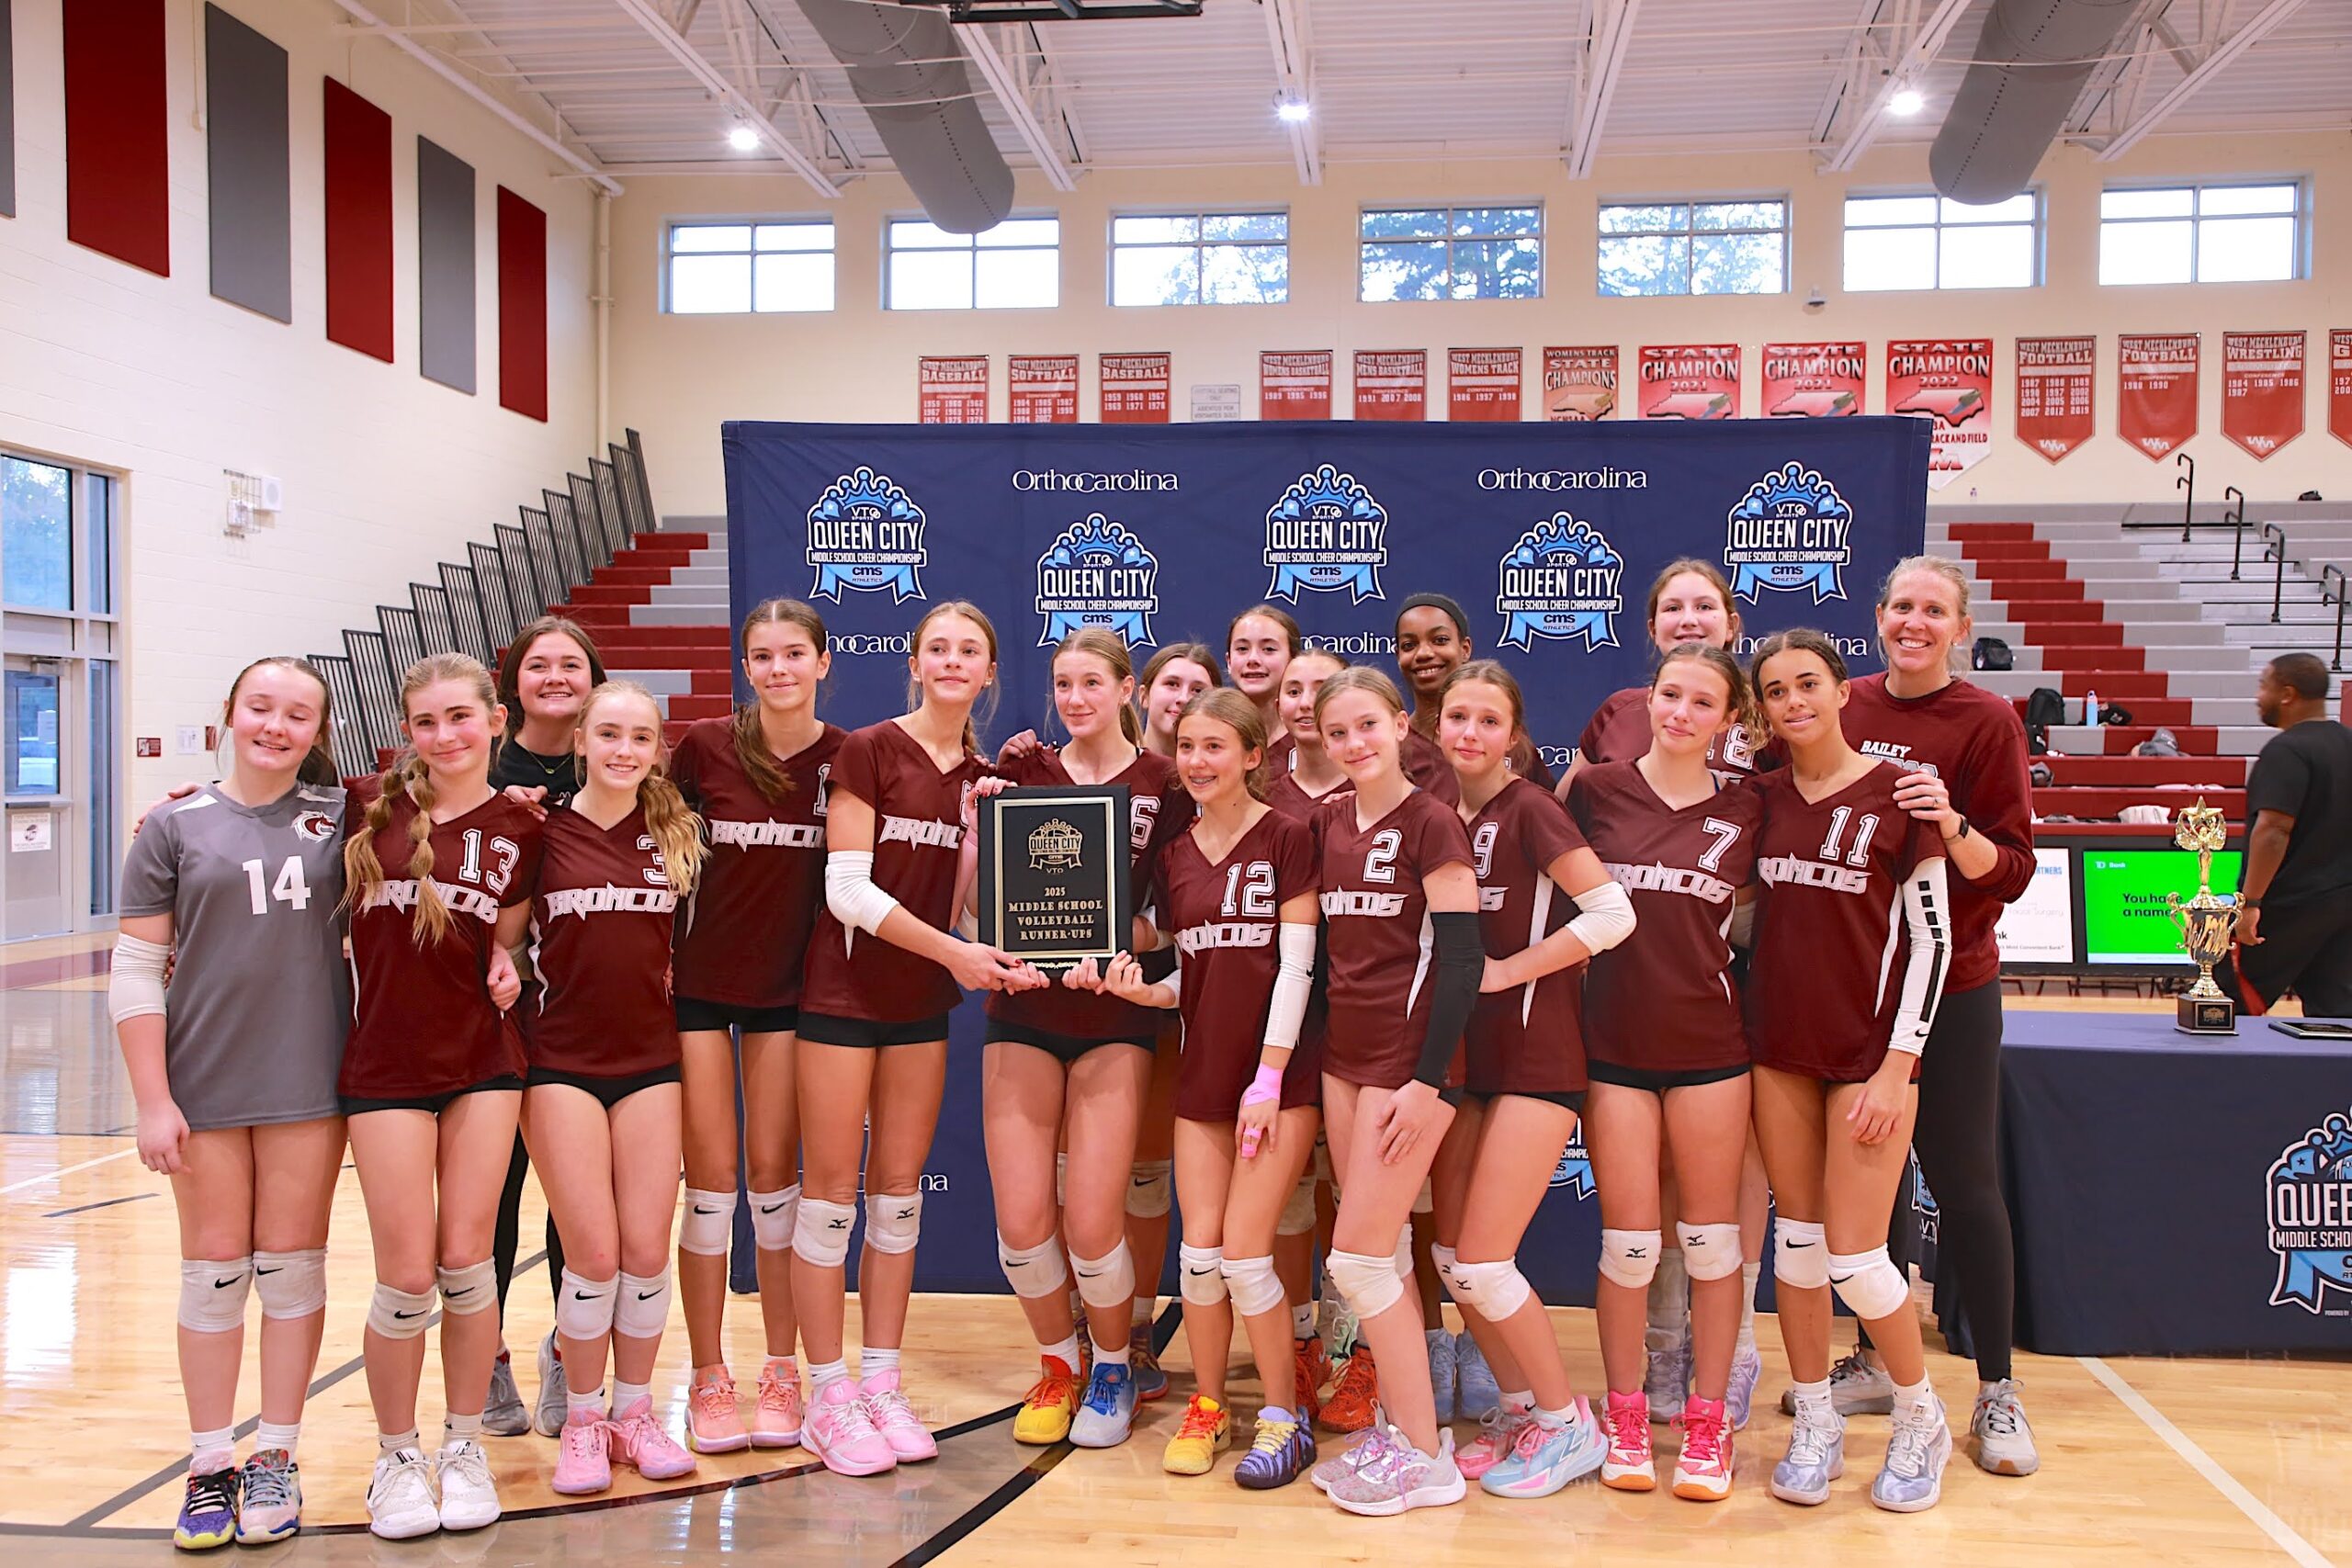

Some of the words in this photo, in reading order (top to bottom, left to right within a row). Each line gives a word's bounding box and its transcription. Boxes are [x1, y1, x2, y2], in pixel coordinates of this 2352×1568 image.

[1893, 343, 1984, 353] STATE
[2019, 343, 2039, 351] WEST
[2041, 342, 2092, 353] MECKLENBURG
[2122, 340, 2143, 350] WEST
[2144, 339, 2196, 351] MECKLENBURG
[2228, 338, 2247, 347] WEST
[2250, 336, 2302, 348] MECKLENBURG
[1645, 348, 1734, 358] STATE
[1769, 346, 1858, 356] STATE
[2019, 351, 2092, 364] FOOTBALL
[2122, 348, 2196, 362] FOOTBALL
[2227, 346, 2301, 359] WRESTLING
[1379, 363, 1423, 375] BASKETBALL
[1452, 362, 1488, 375] WOMENS
[1490, 361, 1519, 374] TRACK
[1550, 358, 1611, 368] STATE
[1766, 358, 1863, 380] CHAMPION
[1890, 355, 1990, 377] CHAMPION
[922, 369, 985, 381] BASEBALL
[1012, 368, 1076, 380] SOFTBALL
[1102, 367, 1167, 379] BASEBALL
[1642, 360, 1737, 382] CHAMPION
[1545, 370, 1616, 390] CHAMPIONS
[1671, 381, 1707, 391] 2021
[1794, 379, 1831, 389] 2021
[1919, 377, 1958, 387] 2022
[2021, 398, 2040, 406] 2004
[2021, 408, 2040, 416] 2007
[2045, 407, 2064, 415] 2012
[2071, 406, 2089, 414] 2019
[1951, 434, 1966, 443] AND
[1968, 434, 1987, 442] FIELD
[1012, 469, 1178, 493] OrthoCarolina
[1477, 467, 1647, 491] OrthoCarolina
[813, 522, 873, 549] QUEEN
[879, 522, 919, 550] CITY
[1272, 522, 1332, 549] QUEEN
[1340, 522, 1380, 549] CITY
[1734, 520, 1796, 547] QUEEN
[1804, 519, 1845, 547] CITY
[811, 552, 833, 562] MIDDLE
[834, 552, 856, 562] SCHOOL
[857, 553, 876, 563] CHEER
[877, 553, 922, 563] CHAMPIONSHIP
[1269, 552, 1291, 562] MIDDLE
[1292, 552, 1316, 562] SCHOOL
[1317, 553, 1335, 563] CHEER
[1337, 553, 1382, 563] CHAMPIONSHIP
[1730, 551, 1752, 561] MIDDLE
[1753, 551, 1777, 561] SCHOOL
[1779, 552, 1797, 561] CHEER
[1799, 552, 1845, 562] CHAMPIONSHIP
[852, 567, 883, 575] cms
[1310, 567, 1341, 575] cms
[1771, 566, 1804, 574] cms
[1044, 570, 1104, 597] QUEEN
[1111, 570, 1150, 597] CITY
[1506, 569, 1568, 597] QUEEN
[1575, 569, 1615, 597] CITY
[1041, 600, 1063, 610] MIDDLE
[1064, 600, 1087, 610] SCHOOL
[1088, 601, 1106, 611] CHEER
[1108, 601, 1152, 611] CHAMPIONSHIP
[1502, 600, 1524, 610] MIDDLE
[1525, 600, 1549, 610] SCHOOL
[1550, 601, 1568, 610] CHEER
[1570, 601, 1616, 611] CHAMPIONSHIP
[1081, 615, 1113, 623] cms
[1544, 615, 1576, 623] cms
[826, 631, 915, 654] hoCarol
[1707, 723, 1755, 770] 8
[1860, 740, 1911, 758] BAILEY
[1130, 795, 1160, 849] 6
[709, 817, 824, 852] BRONCO
[878, 815, 962, 852] BRONC
[1819, 806, 1880, 867] 11
[1031, 839, 1058, 849] QUEEN
[1061, 838, 1080, 849] CITY
[1698, 817, 1742, 873] 7
[1363, 829, 1402, 884] 2
[1473, 822, 1498, 879] 9
[458, 829, 519, 896] 13
[637, 835, 670, 886] 3
[1758, 852, 1873, 895] RONCOS
[243, 855, 311, 915] 14
[1221, 861, 1275, 917] 12
[1044, 887, 1066, 897] 2025
[544, 881, 679, 924] BRONCOS
[1318, 885, 1409, 924] RONCOS
[2123, 894, 2146, 904] You
[2150, 894, 2183, 903] hae
[1008, 901, 1055, 912] MIDDLE
[1057, 900, 1102, 910] SCHOOL
[1017, 915, 1094, 926] VOLLEYBALL
[1020, 929, 1092, 941] RUNNER-UPS
[1173, 919, 1276, 960] RONCOS
[2277, 1183, 2352, 1226] QUEE
[2276, 1232, 2318, 1247] MIDDLE
[2320, 1232, 2352, 1247] SCHO
